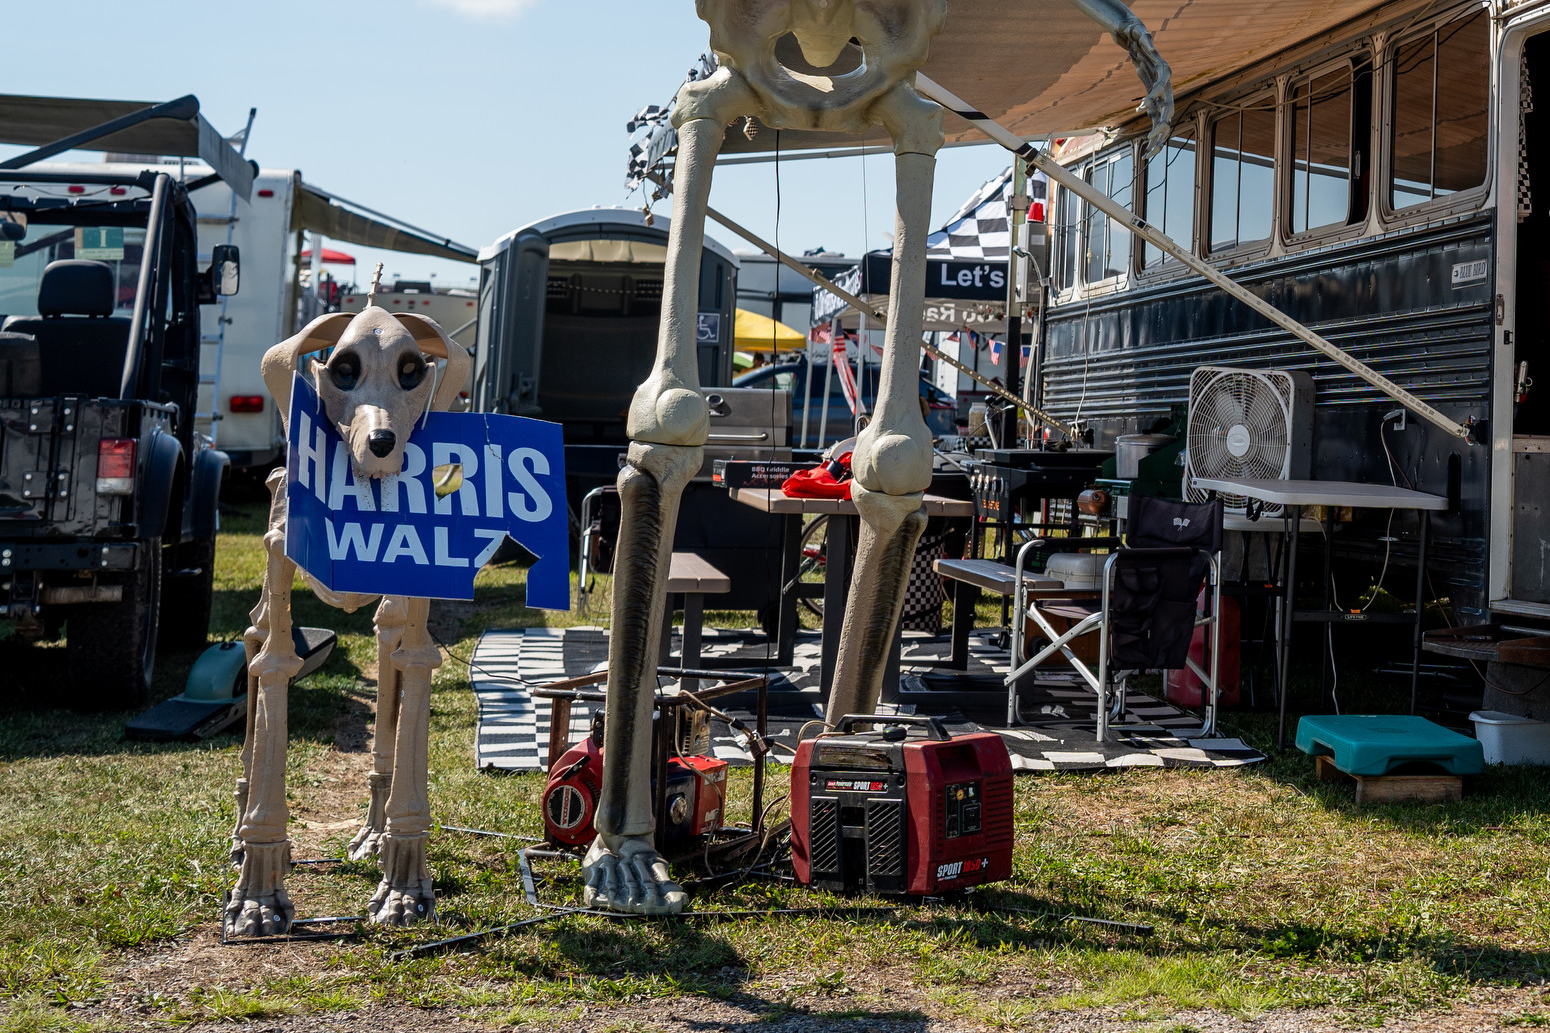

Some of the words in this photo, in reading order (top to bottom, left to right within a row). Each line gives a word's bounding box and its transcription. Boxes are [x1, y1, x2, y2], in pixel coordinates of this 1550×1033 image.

[941, 263, 1004, 288] Let's
[298, 411, 553, 523] HARRIS
[853, 781, 870, 790] SPORT
[937, 861, 963, 878] SPORT
